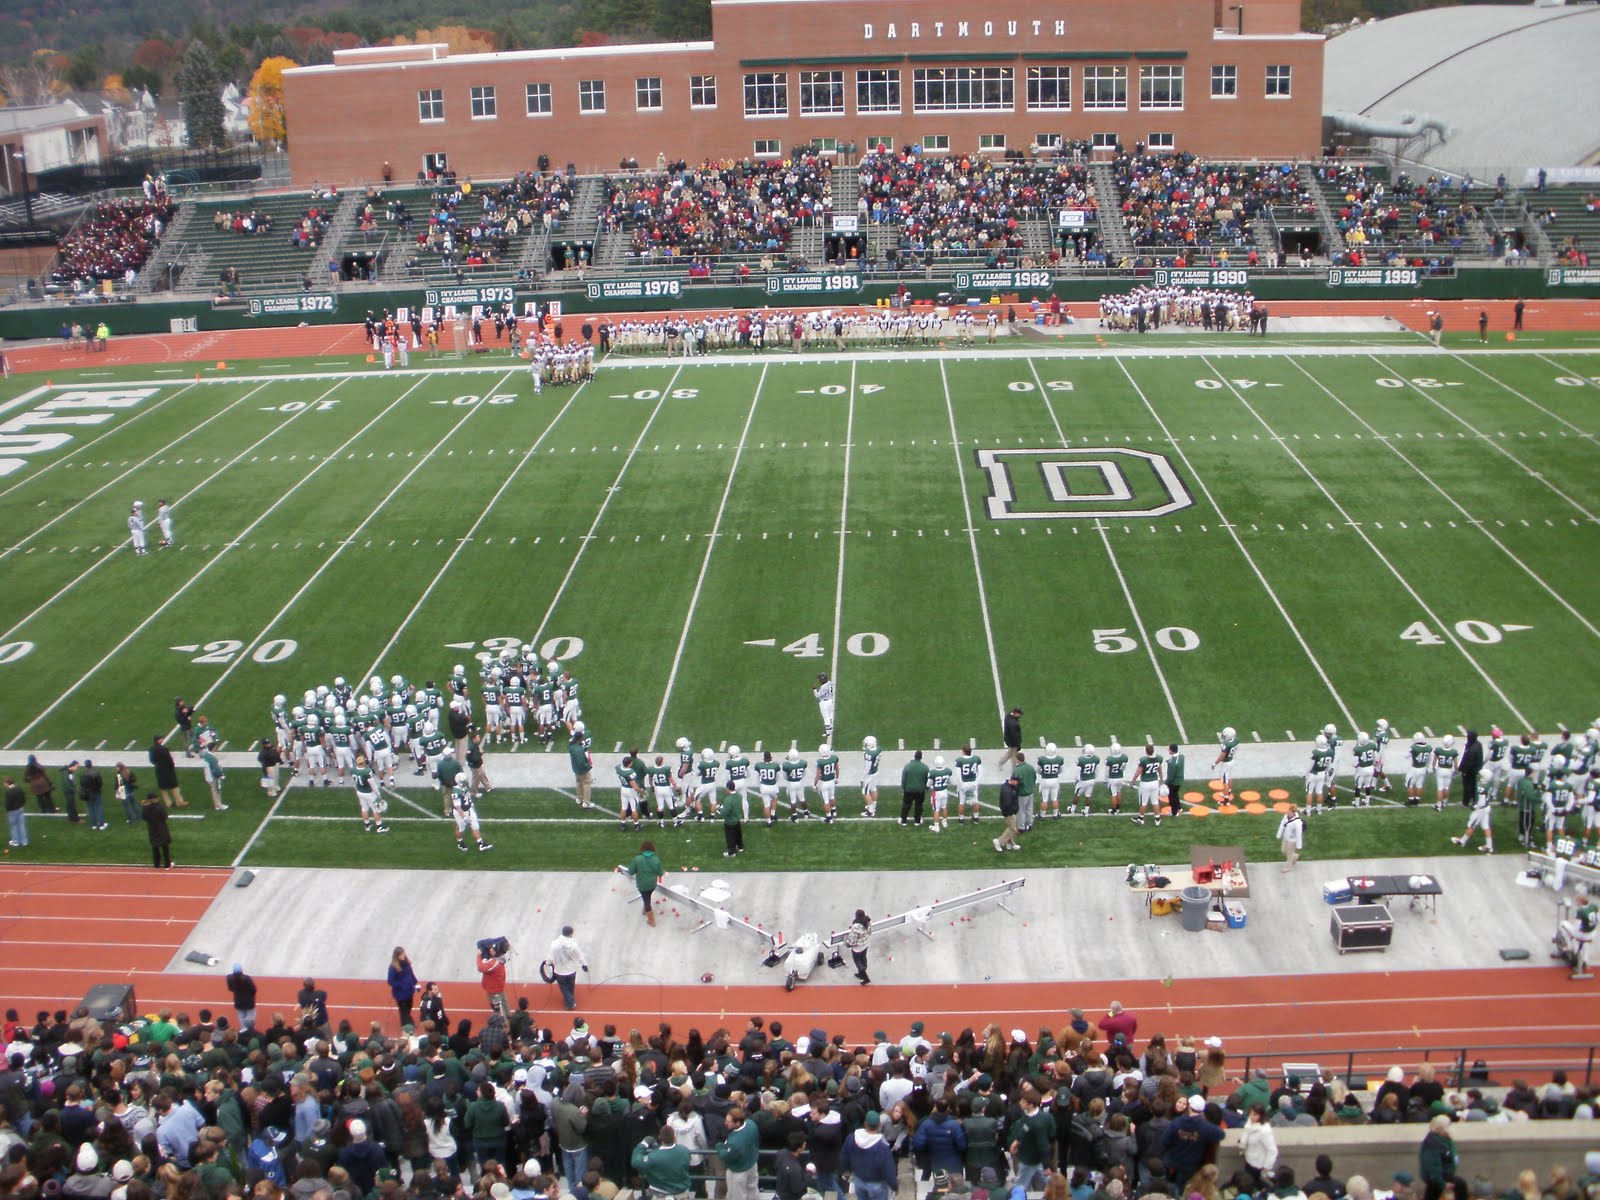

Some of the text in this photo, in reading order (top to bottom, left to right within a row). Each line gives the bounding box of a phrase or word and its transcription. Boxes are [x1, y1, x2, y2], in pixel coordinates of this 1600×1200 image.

[864, 20, 1065, 38] DARTMOUTH
[825, 275, 859, 290] 1981
[1014, 272, 1049, 286] 1982
[1212, 270, 1246, 285] 1990
[1344, 276, 1381, 284] CHAMPIONS
[1384, 270, 1416, 284] 1991
[604, 288, 641, 296] CHAMPIONS
[644, 280, 679, 295] 1978
[783, 283, 821, 291] CHAMPIONS
[442, 296, 477, 304] CHAMPIONS
[480, 287, 513, 302] 1973
[301, 296, 333, 310] 1972
[506, 692, 520, 703] 26
[392, 712, 406, 723] 97
[369, 731, 386, 745] 85
[789, 767, 805, 778] 45
[823, 762, 836, 775] 81
[962, 763, 977, 775] 54
[1043, 764, 1060, 774] 95
[1146, 762, 1160, 774] 72
[760, 769, 775, 780] 80
